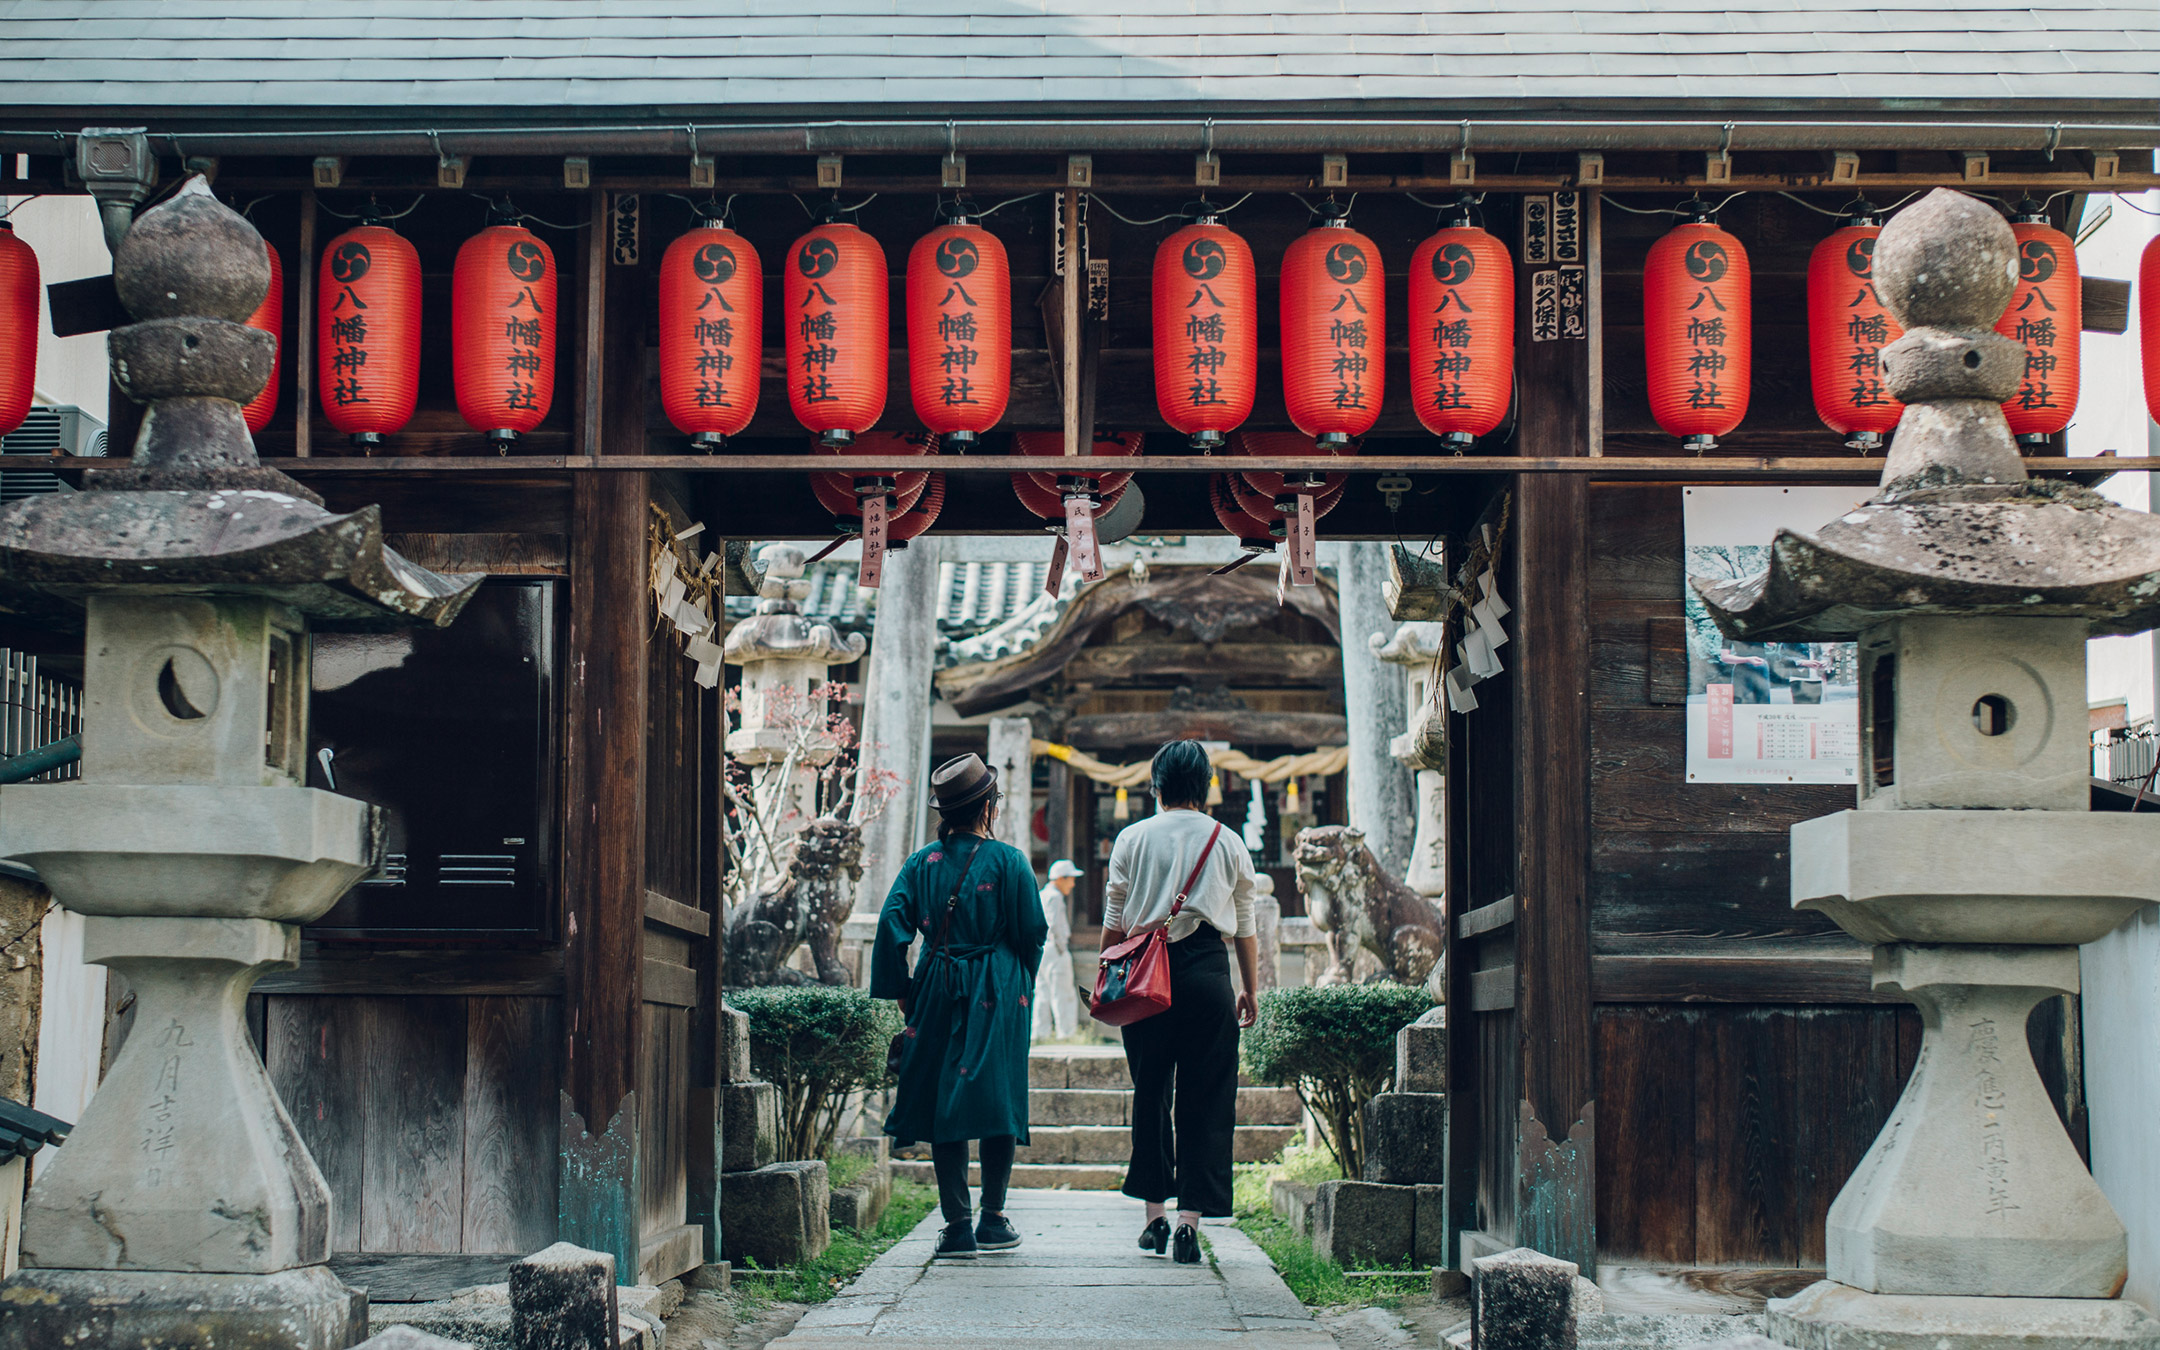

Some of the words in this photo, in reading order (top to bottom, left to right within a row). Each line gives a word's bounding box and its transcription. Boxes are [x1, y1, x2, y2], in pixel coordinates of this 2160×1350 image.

[331, 285, 370, 407] 八幡神社
[505, 286, 543, 411] 八幡神社
[694, 287, 734, 408] 八幡神社
[800, 282, 839, 405] 八幡神社
[938, 282, 978, 406] 八幡神社
[1186, 283, 1227, 406] 八幡神社
[1330, 289, 1368, 410] 八幡神社
[1433, 289, 1472, 411] 八幡神社
[1686, 287, 1727, 410] 八幡神社
